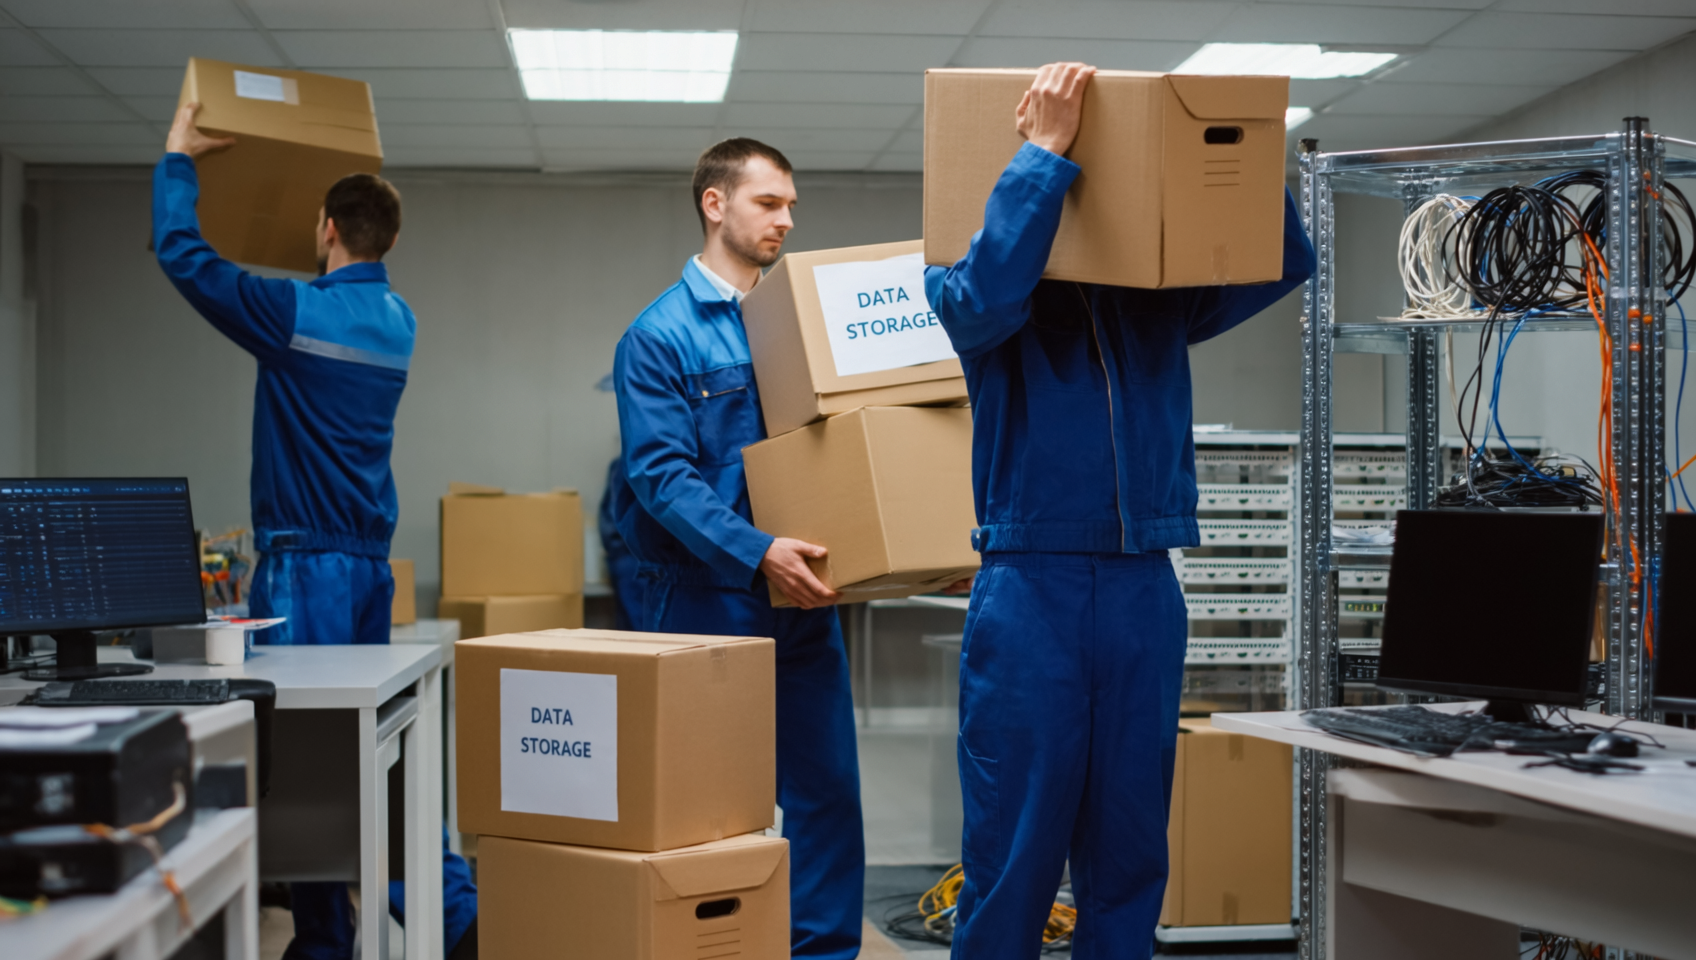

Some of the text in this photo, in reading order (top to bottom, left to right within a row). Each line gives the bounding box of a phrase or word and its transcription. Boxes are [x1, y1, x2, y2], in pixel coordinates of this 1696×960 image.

[857, 286, 910, 308] DATA
[846, 311, 938, 340] STORAGE
[531, 707, 573, 726] DATA
[520, 736, 592, 758] STORAGE
